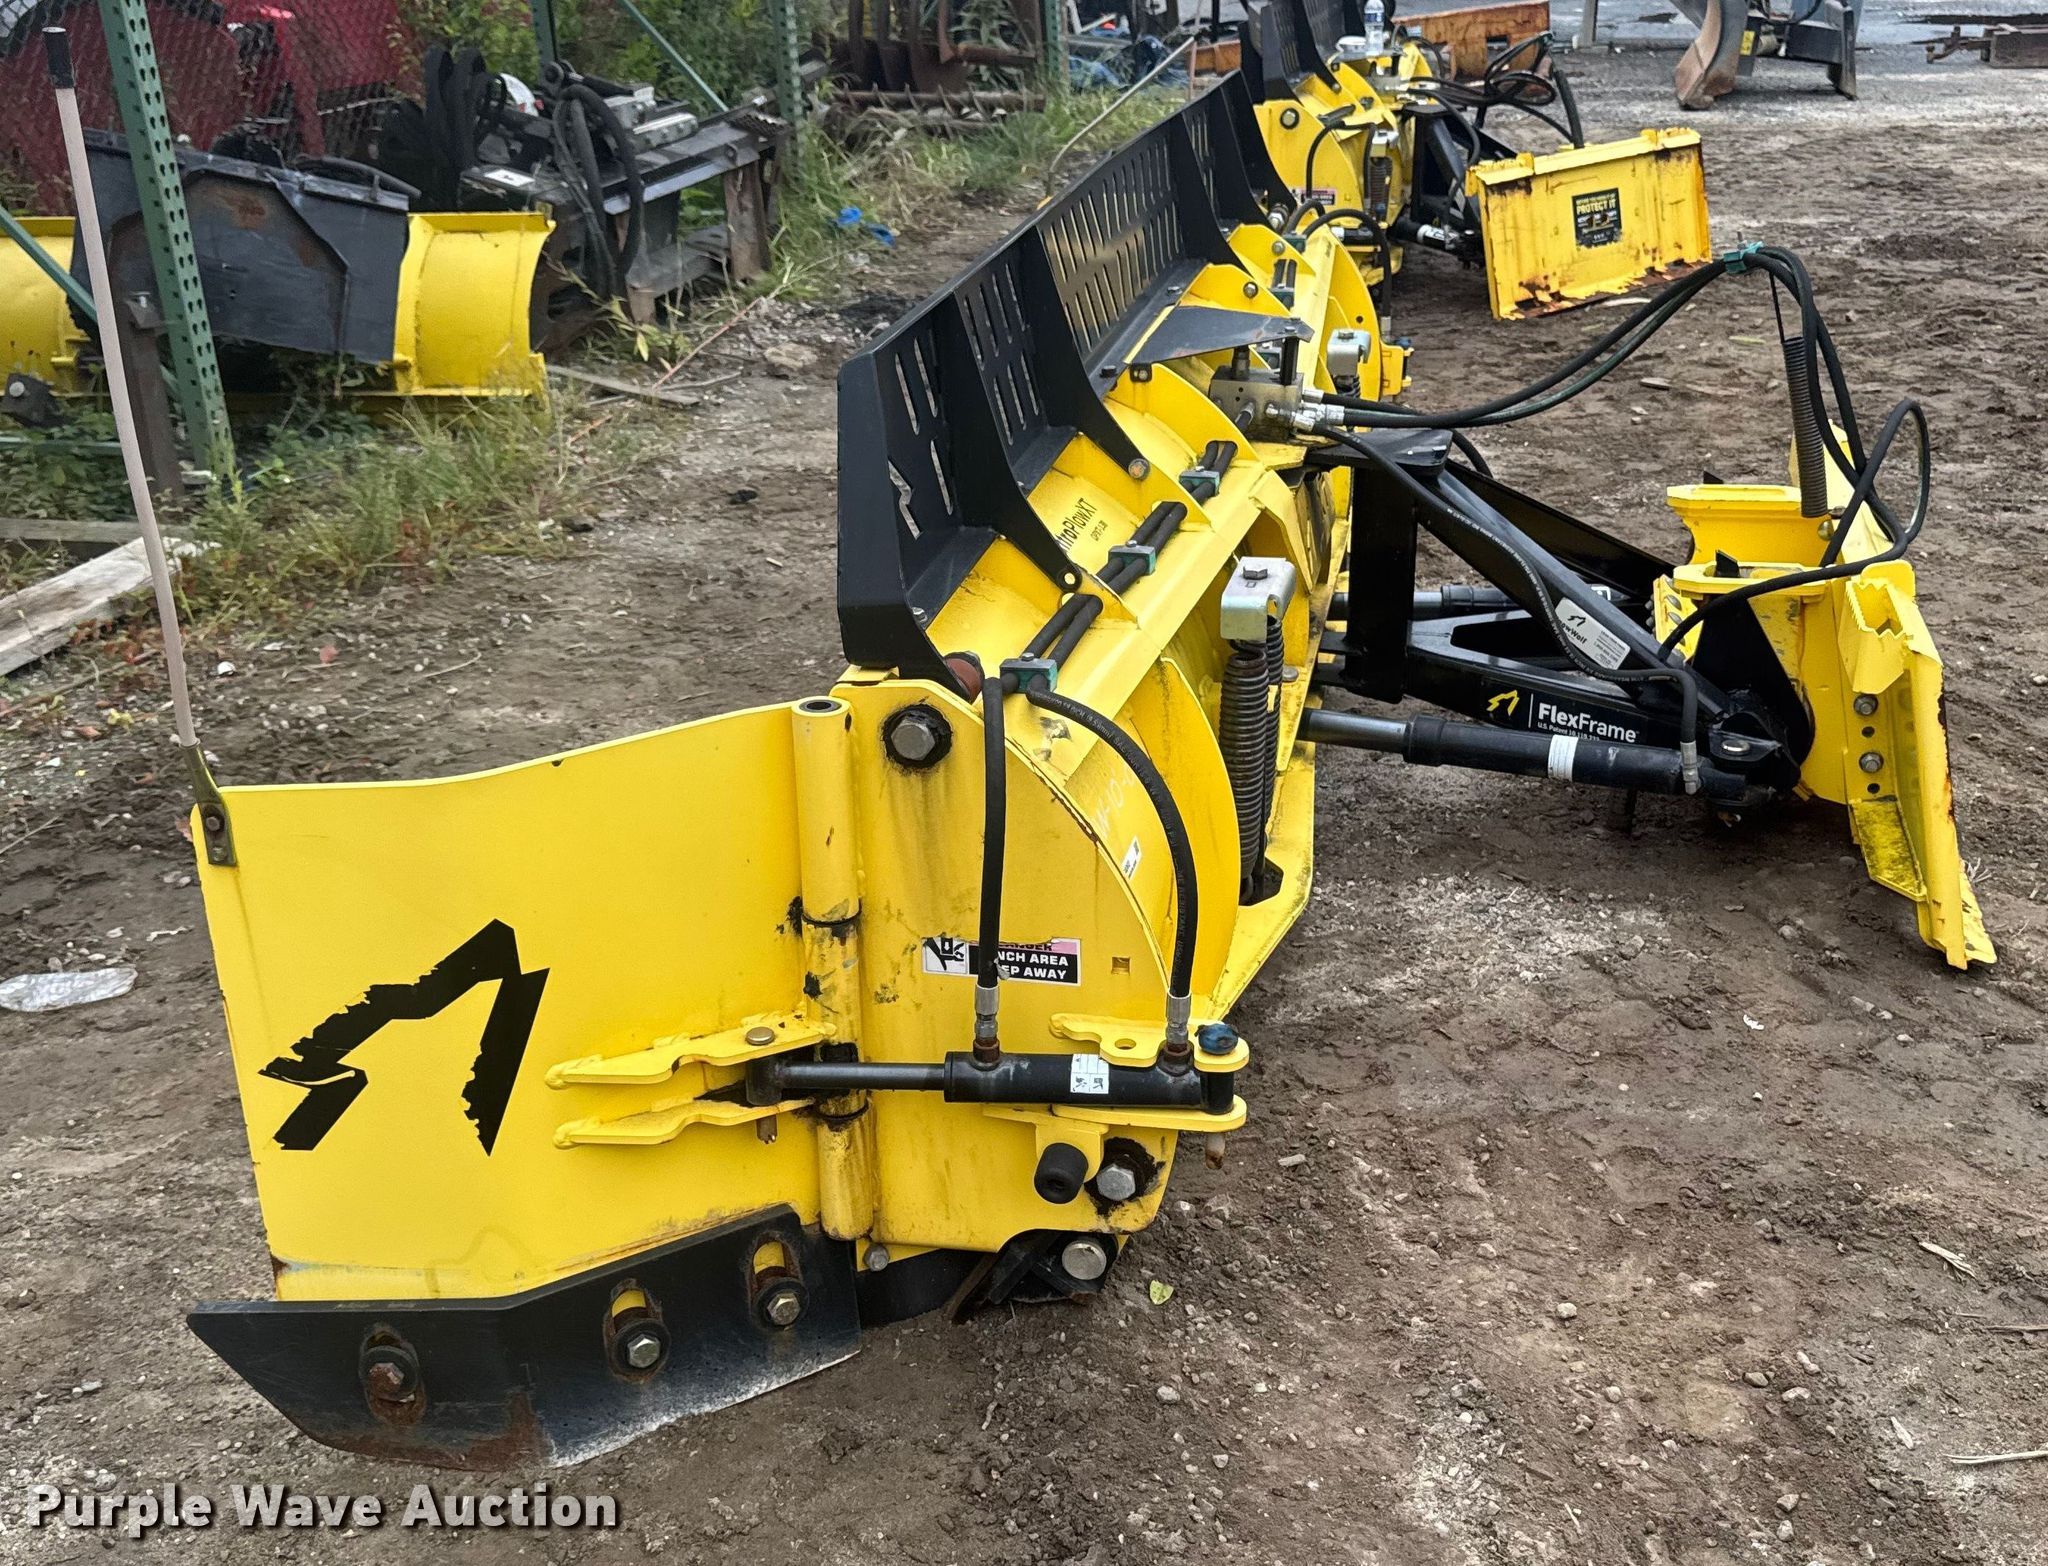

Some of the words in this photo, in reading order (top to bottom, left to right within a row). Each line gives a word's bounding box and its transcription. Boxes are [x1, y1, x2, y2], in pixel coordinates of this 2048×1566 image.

[1576, 200, 1607, 215] PROTECT
[1608, 198, 1616, 209] IT
[1538, 702, 1637, 743] FlexFrame
[1549, 724, 1568, 736] Patent
[1029, 953, 1069, 966] AREA
[1023, 966, 1067, 979] AWAY
